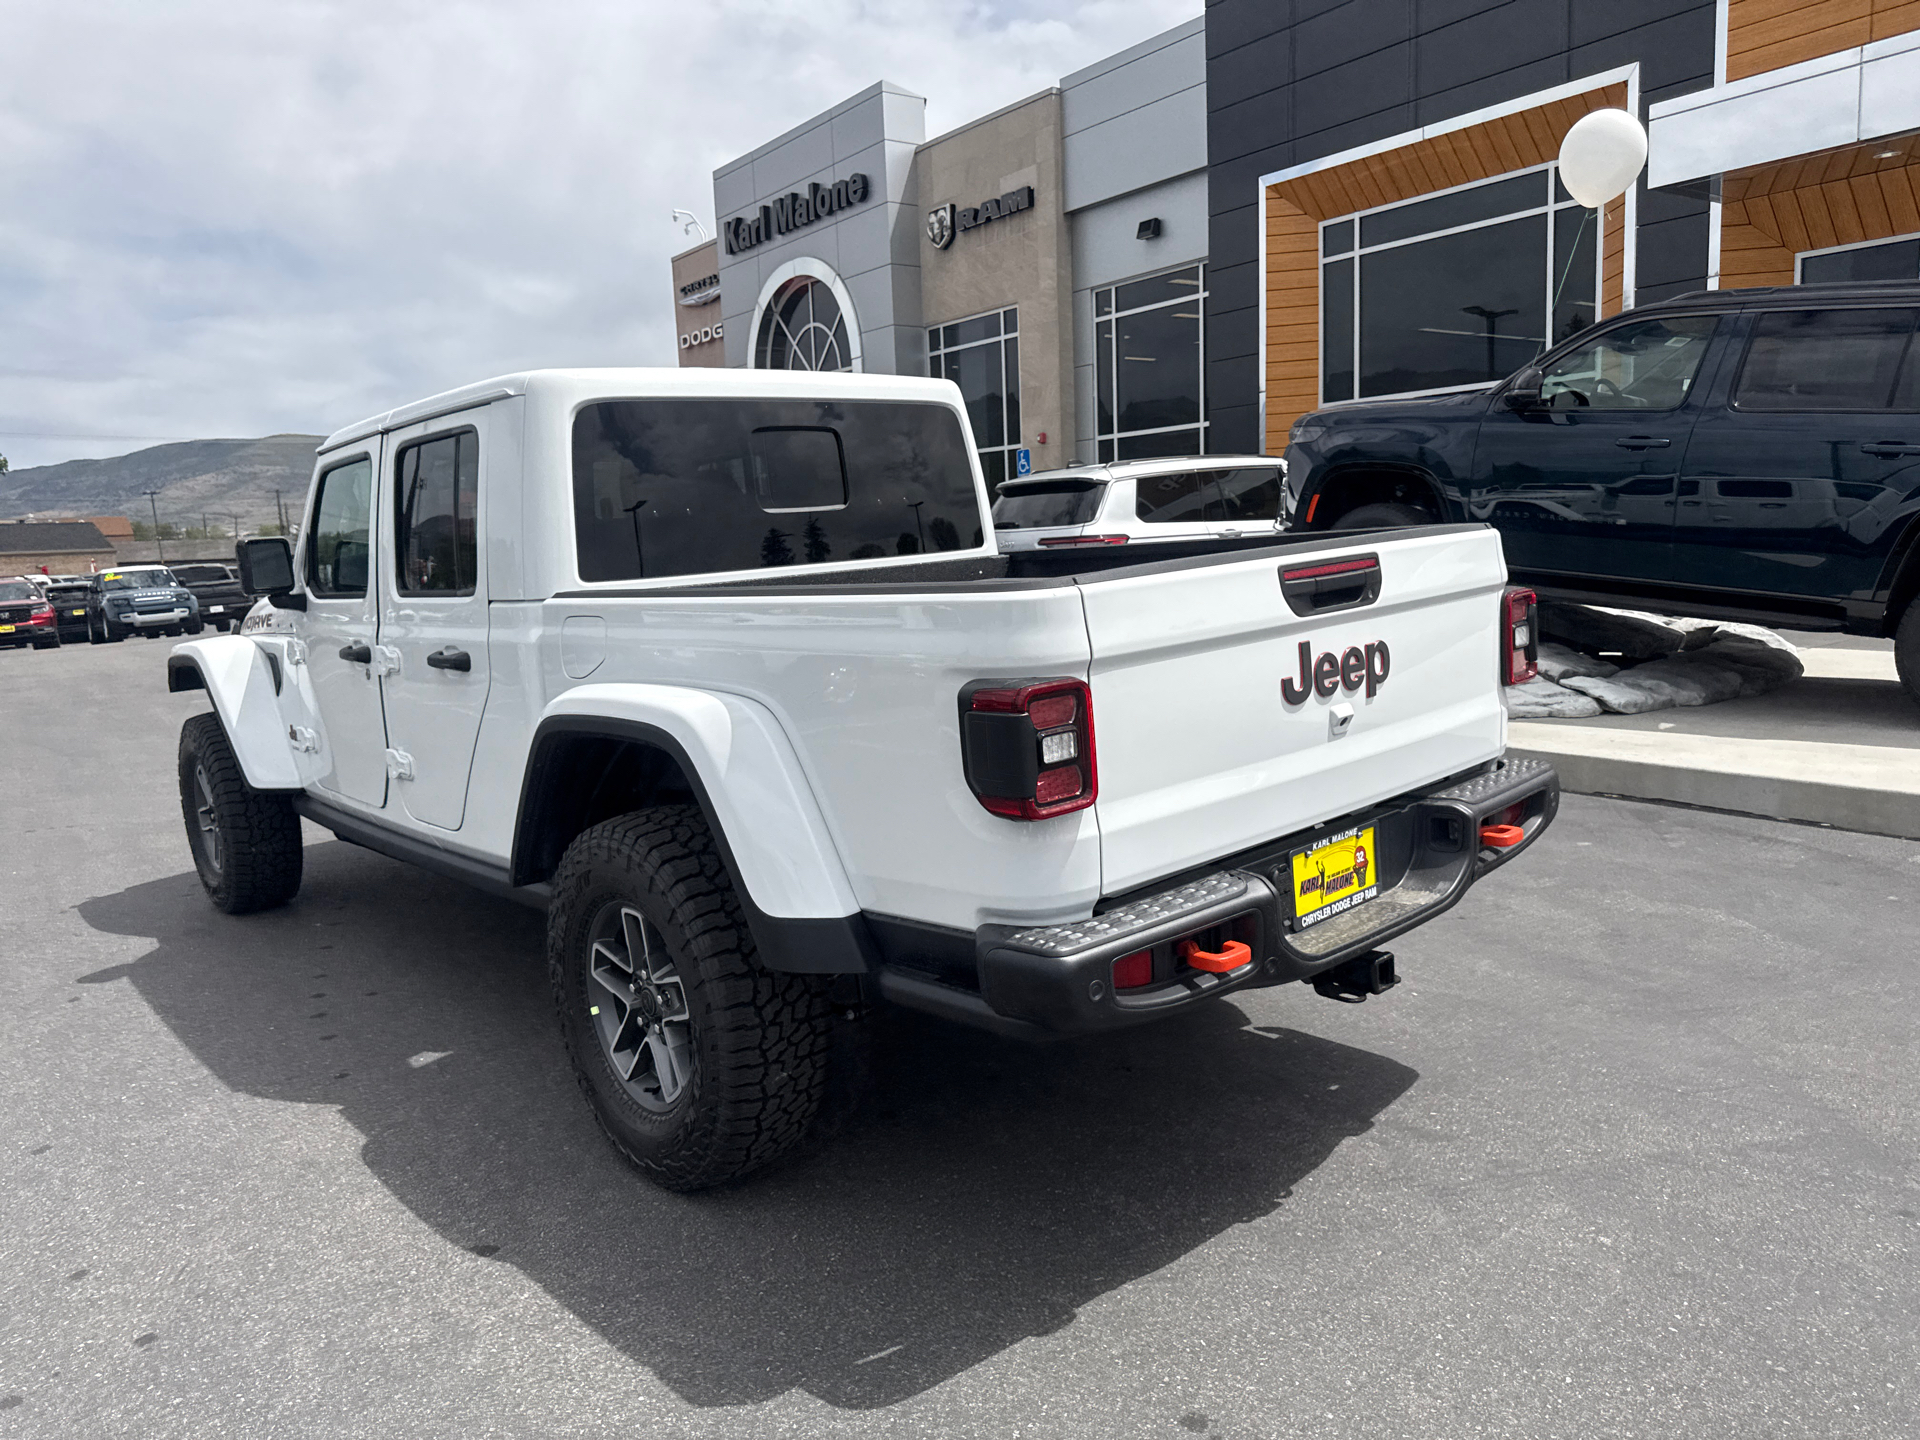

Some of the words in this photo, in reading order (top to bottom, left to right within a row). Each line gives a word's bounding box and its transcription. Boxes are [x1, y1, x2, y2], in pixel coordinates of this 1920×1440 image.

[724, 205, 772, 255] Karl
[773, 173, 869, 235] Malone
[956, 186, 1034, 232] RAM
[1281, 640, 1390, 706] Jeep
[1312, 838, 1330, 851] KARL
[1331, 827, 1358, 844] MALONE
[1356, 851, 1365, 863] 32
[1299, 875, 1320, 897] KARL
[1301, 906, 1331, 928] CHRYSLER
[1331, 897, 1351, 914] DODGE
[1351, 892, 1365, 905] JEEP
[1364, 886, 1377, 900] RAM
